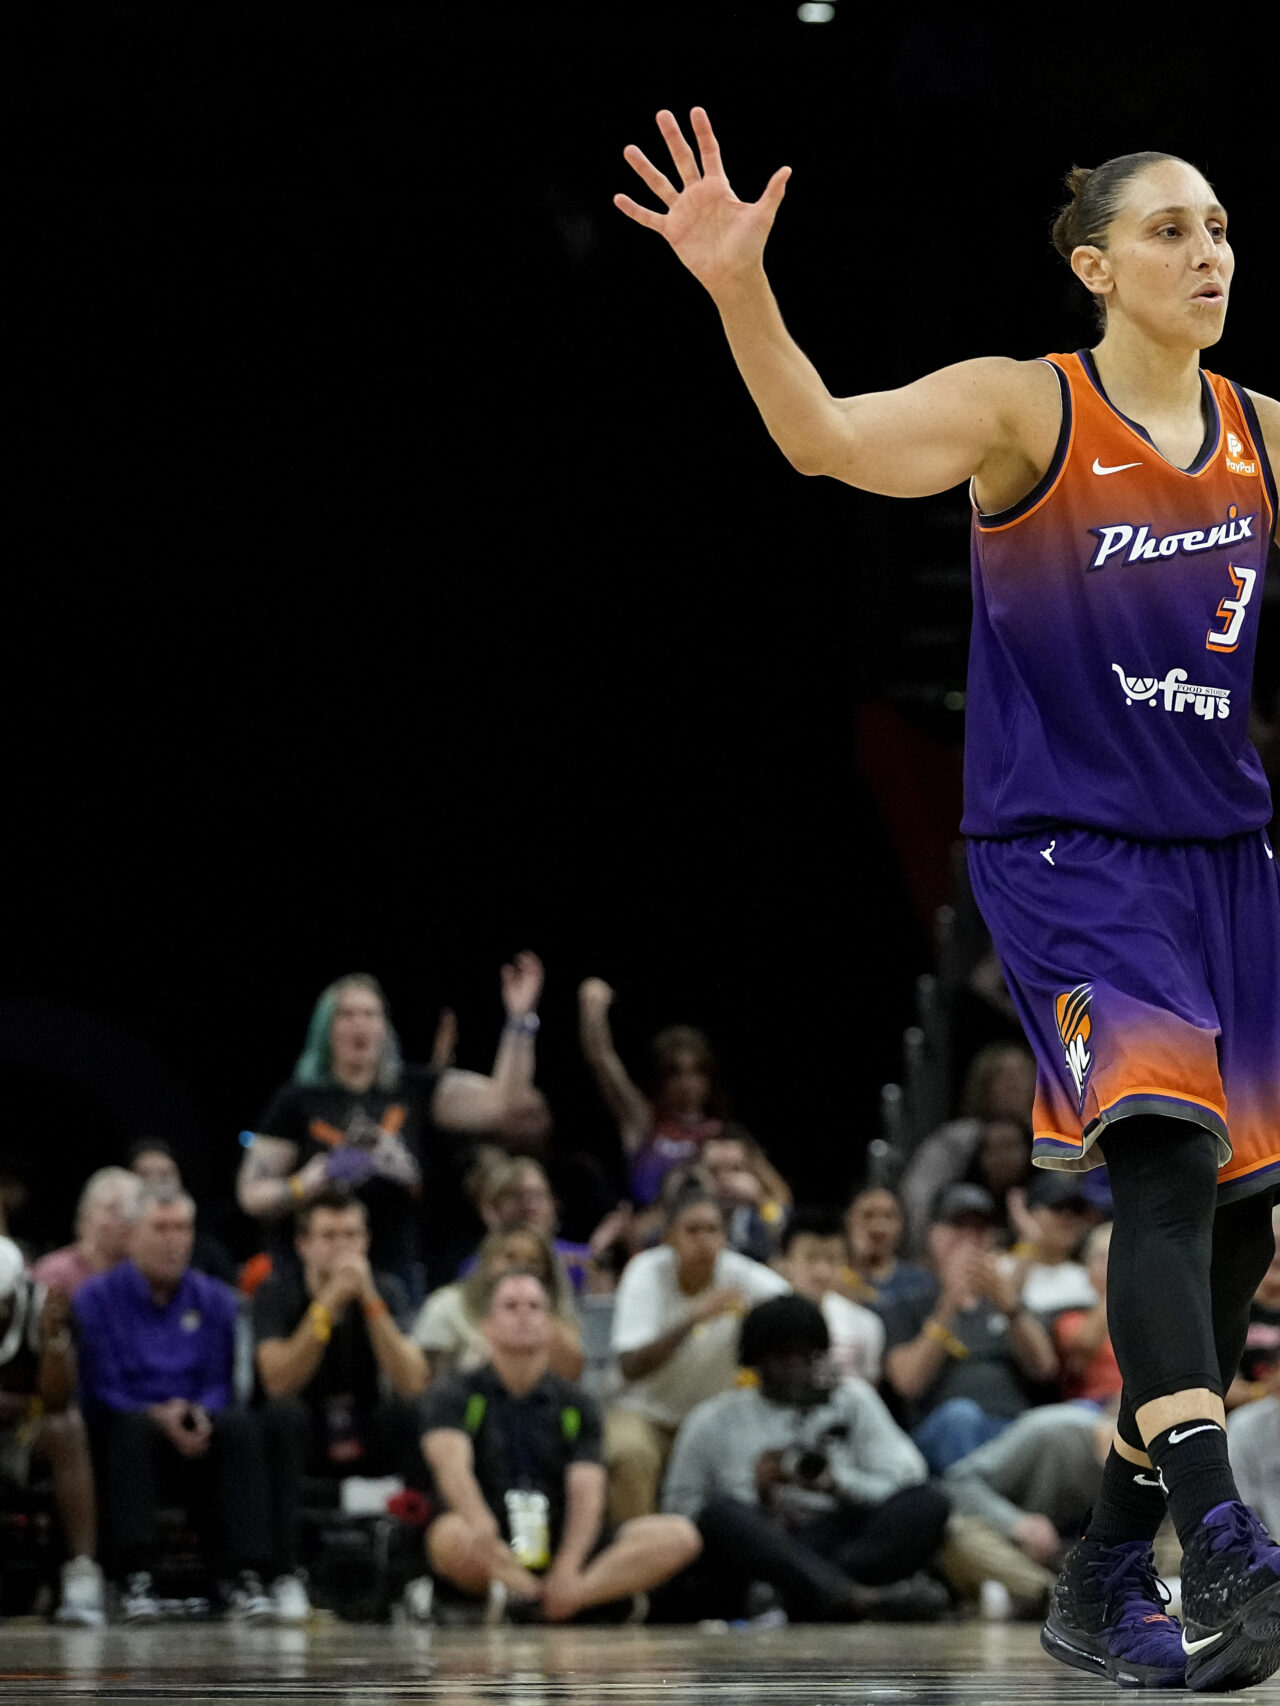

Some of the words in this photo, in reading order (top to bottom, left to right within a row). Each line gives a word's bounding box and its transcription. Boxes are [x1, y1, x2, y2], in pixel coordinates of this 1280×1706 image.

[1226, 457, 1256, 474] PayPal
[1092, 504, 1255, 568] Phoenix
[1206, 562, 1257, 653] 3
[1176, 684, 1203, 694] FOOD
